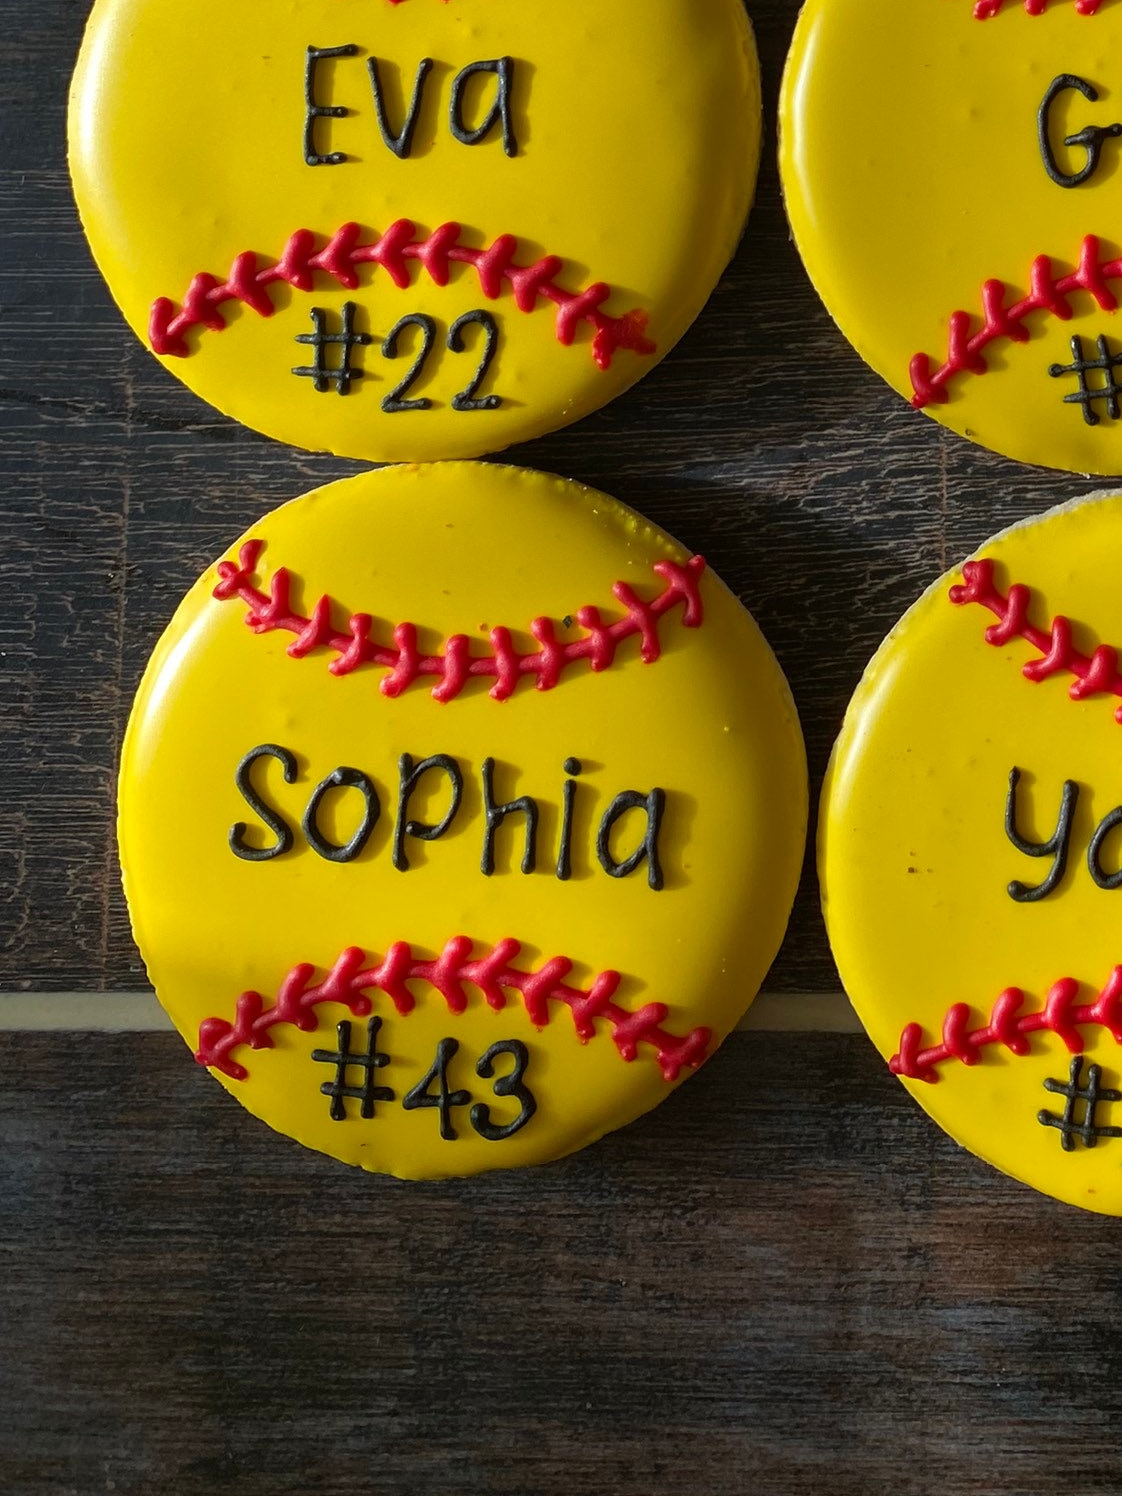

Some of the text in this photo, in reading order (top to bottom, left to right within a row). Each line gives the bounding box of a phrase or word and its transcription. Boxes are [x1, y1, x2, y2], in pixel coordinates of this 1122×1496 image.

[303, 42, 521, 167] Eva
[294, 300, 506, 414] #22
[310, 1014, 541, 1142] #43
